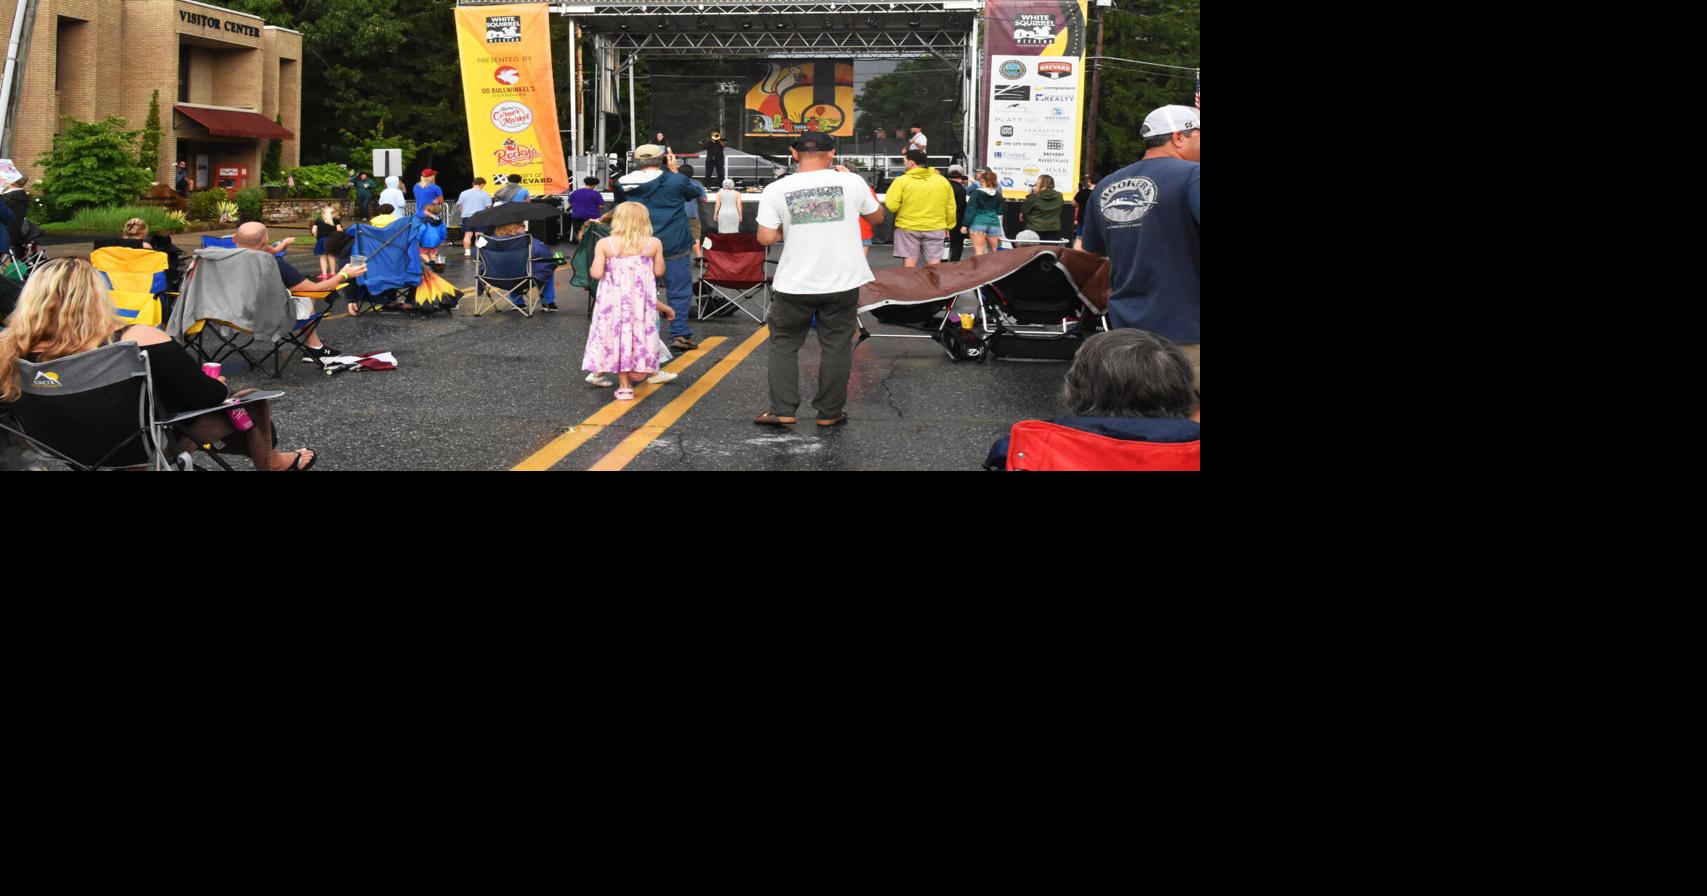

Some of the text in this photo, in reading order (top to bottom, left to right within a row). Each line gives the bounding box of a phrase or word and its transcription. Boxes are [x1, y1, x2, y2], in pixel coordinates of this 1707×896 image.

[179, 10, 260, 38] VISITOR CENTER
[493, 108, 520, 121] Corner
[501, 114, 529, 127] Market
